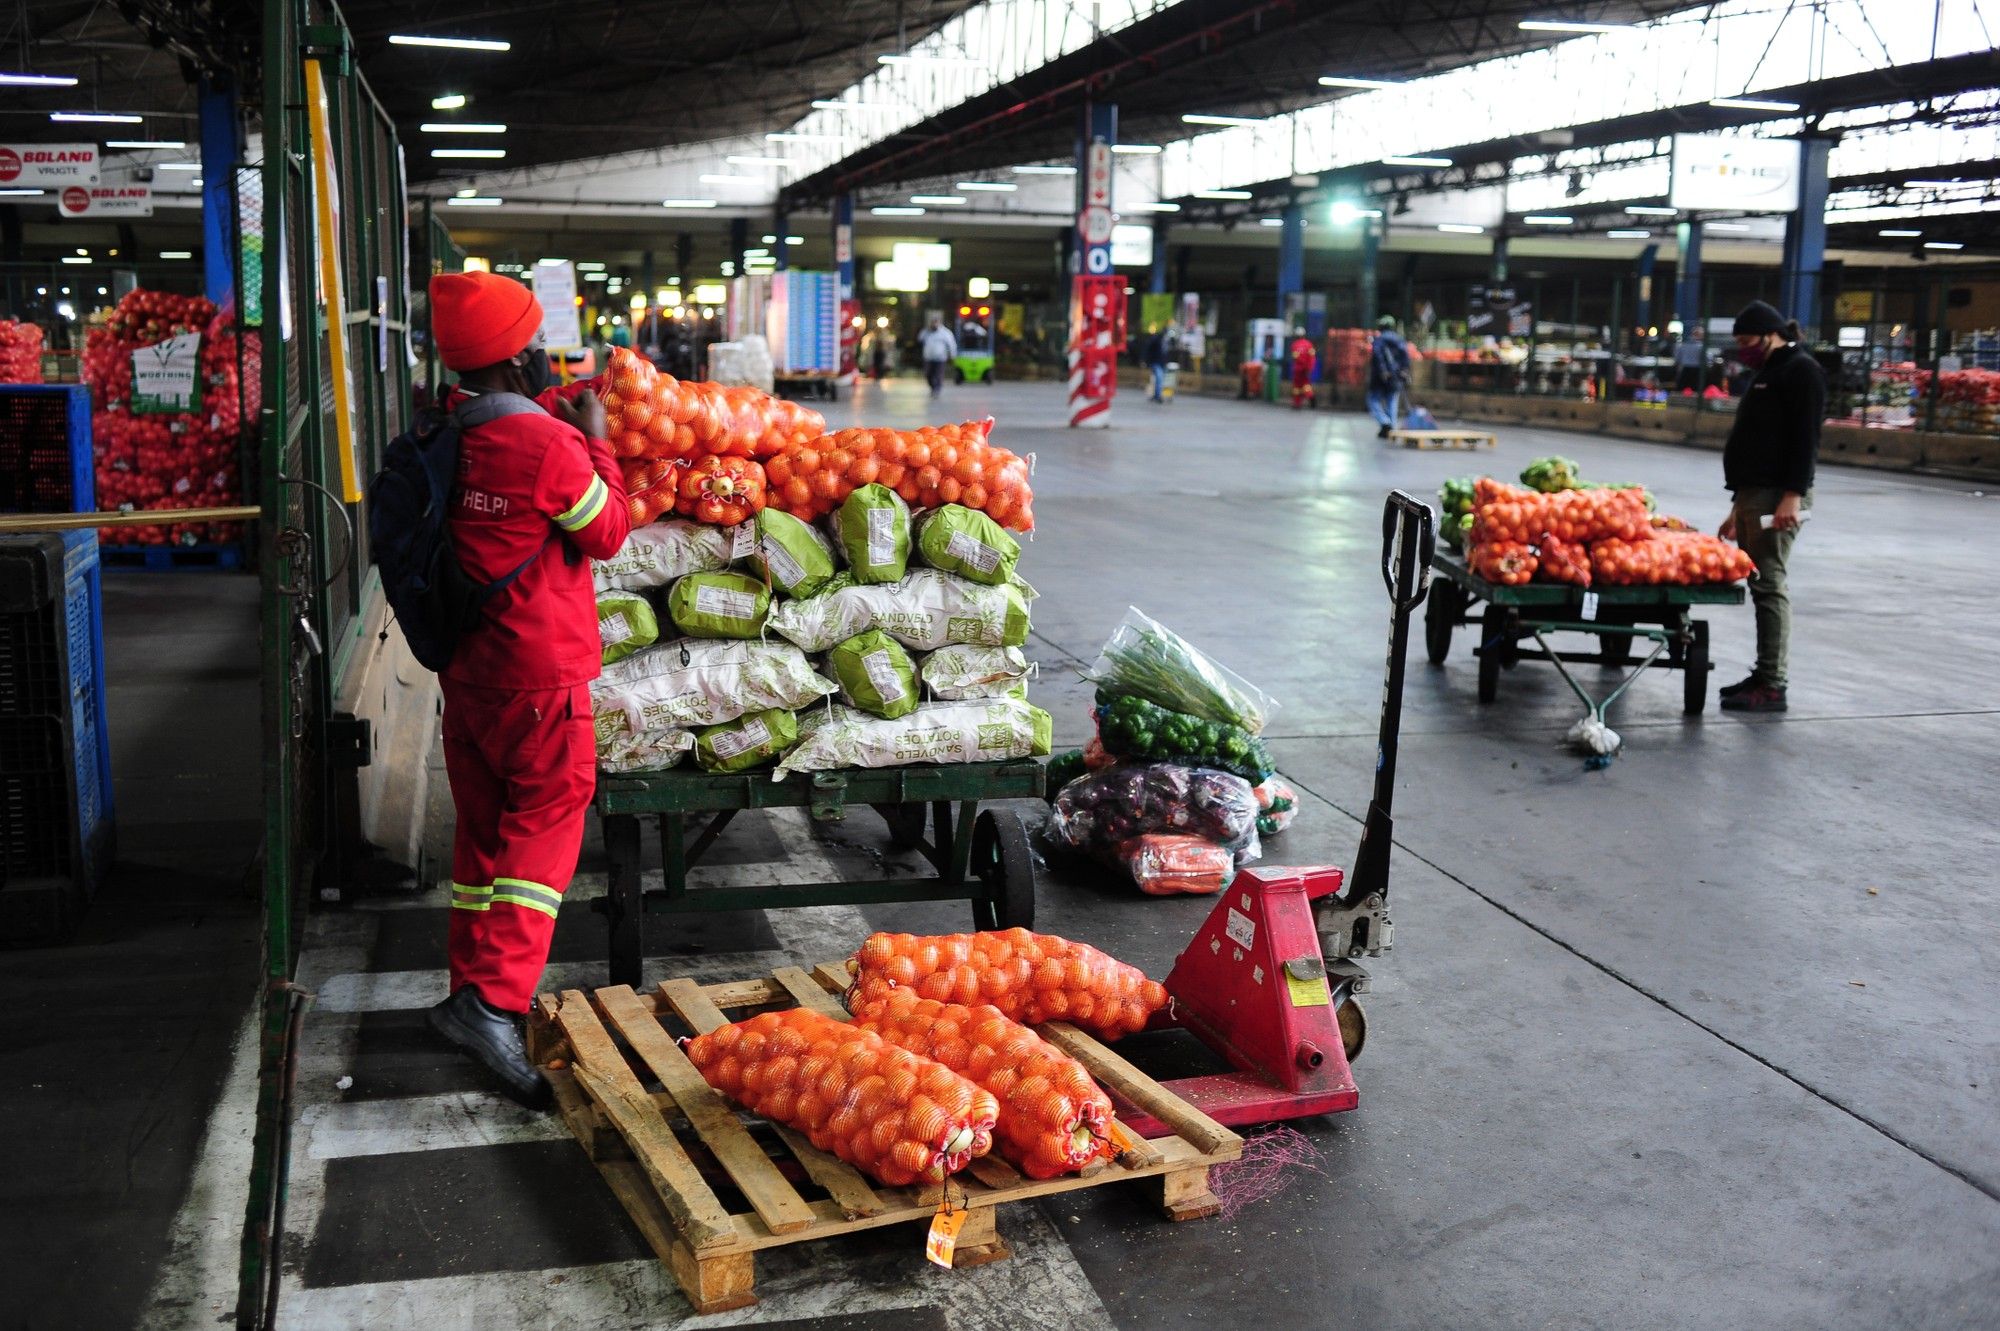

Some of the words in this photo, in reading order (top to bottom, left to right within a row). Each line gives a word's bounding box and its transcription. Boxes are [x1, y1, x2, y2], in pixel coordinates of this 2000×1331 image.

[23, 151, 94, 163] BOLAND
[38, 167, 80, 175] VRUGTE
[91, 188, 147, 198] BOLAND
[139, 371, 192, 379] WORTHING
[463, 489, 508, 515] HELP!
[592, 560, 656, 577] POTATOES
[871, 612, 933, 624] SANDVELD
[643, 696, 708, 717] POTATOES
[647, 711, 713, 729] SANDVELD
[895, 730, 960, 744] POTATOES
[896, 744, 962, 760] SANDVELD
